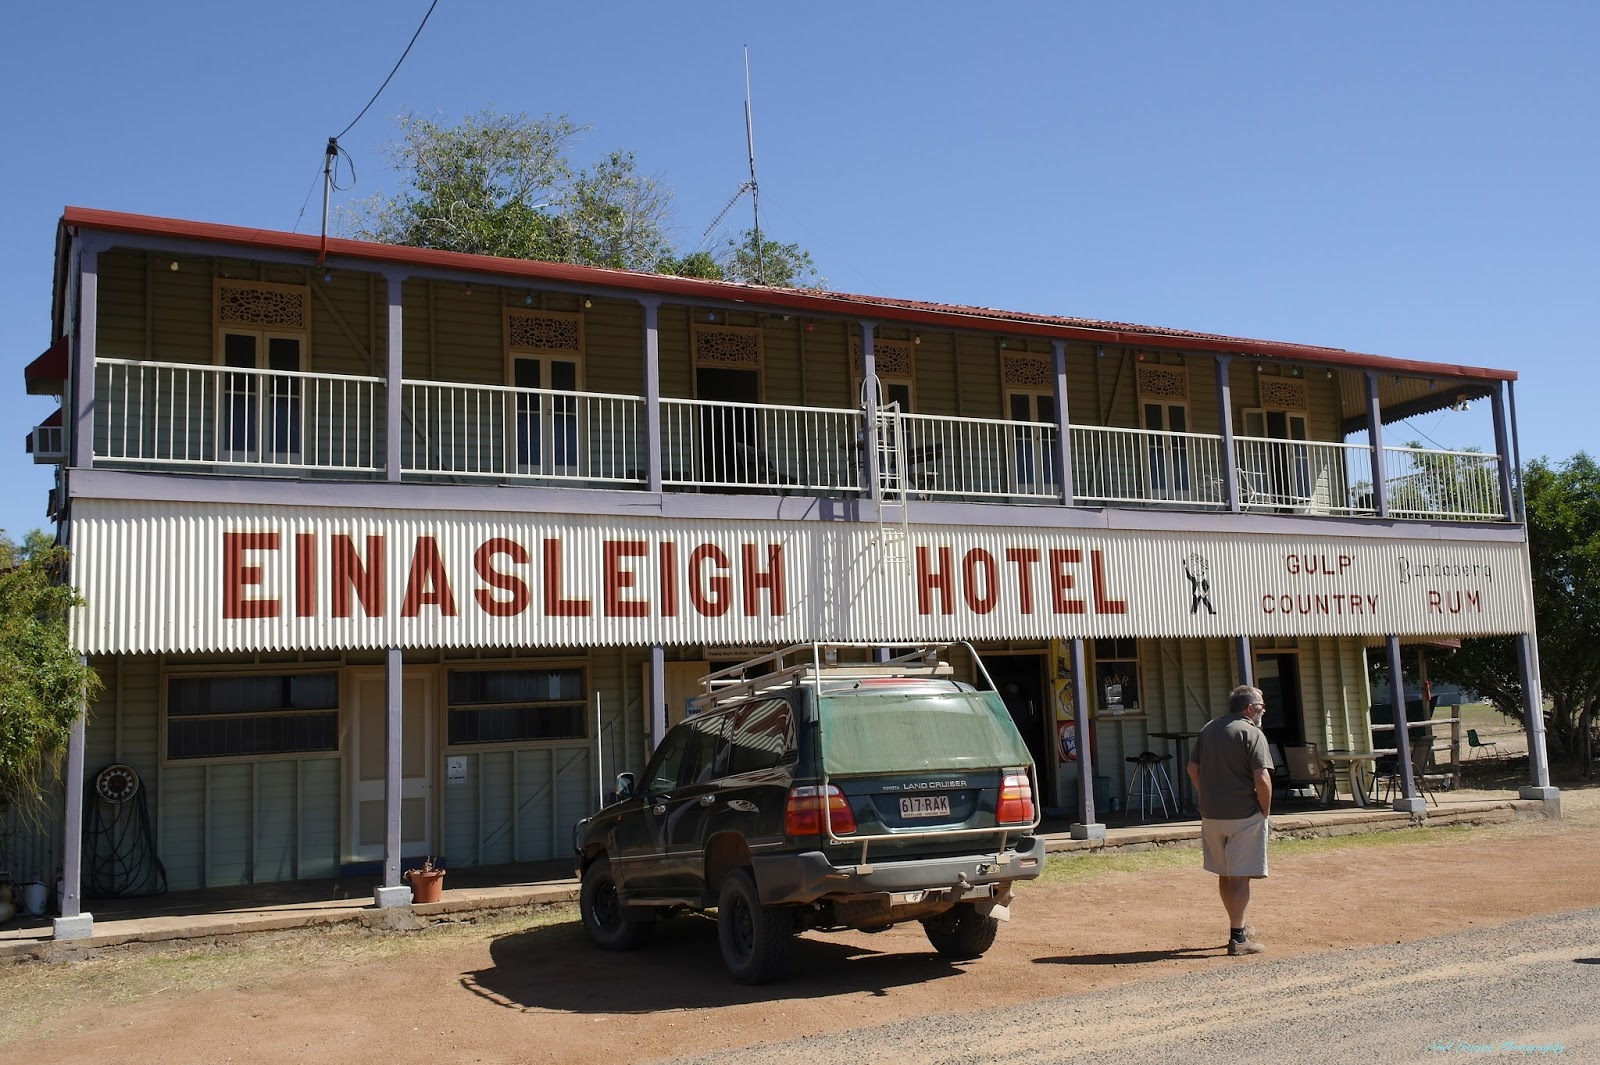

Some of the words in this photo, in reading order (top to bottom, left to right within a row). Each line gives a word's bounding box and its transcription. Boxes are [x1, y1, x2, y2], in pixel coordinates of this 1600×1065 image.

[222, 531, 786, 619] EINASLEIGH
[915, 545, 1128, 616] HOTEL
[1262, 594, 1378, 615] COUNTRY
[1428, 590, 1481, 614] RUM
[1104, 673, 1129, 687] BAR
[903, 782, 928, 790] LAND
[928, 780, 967, 789] CRUISER
